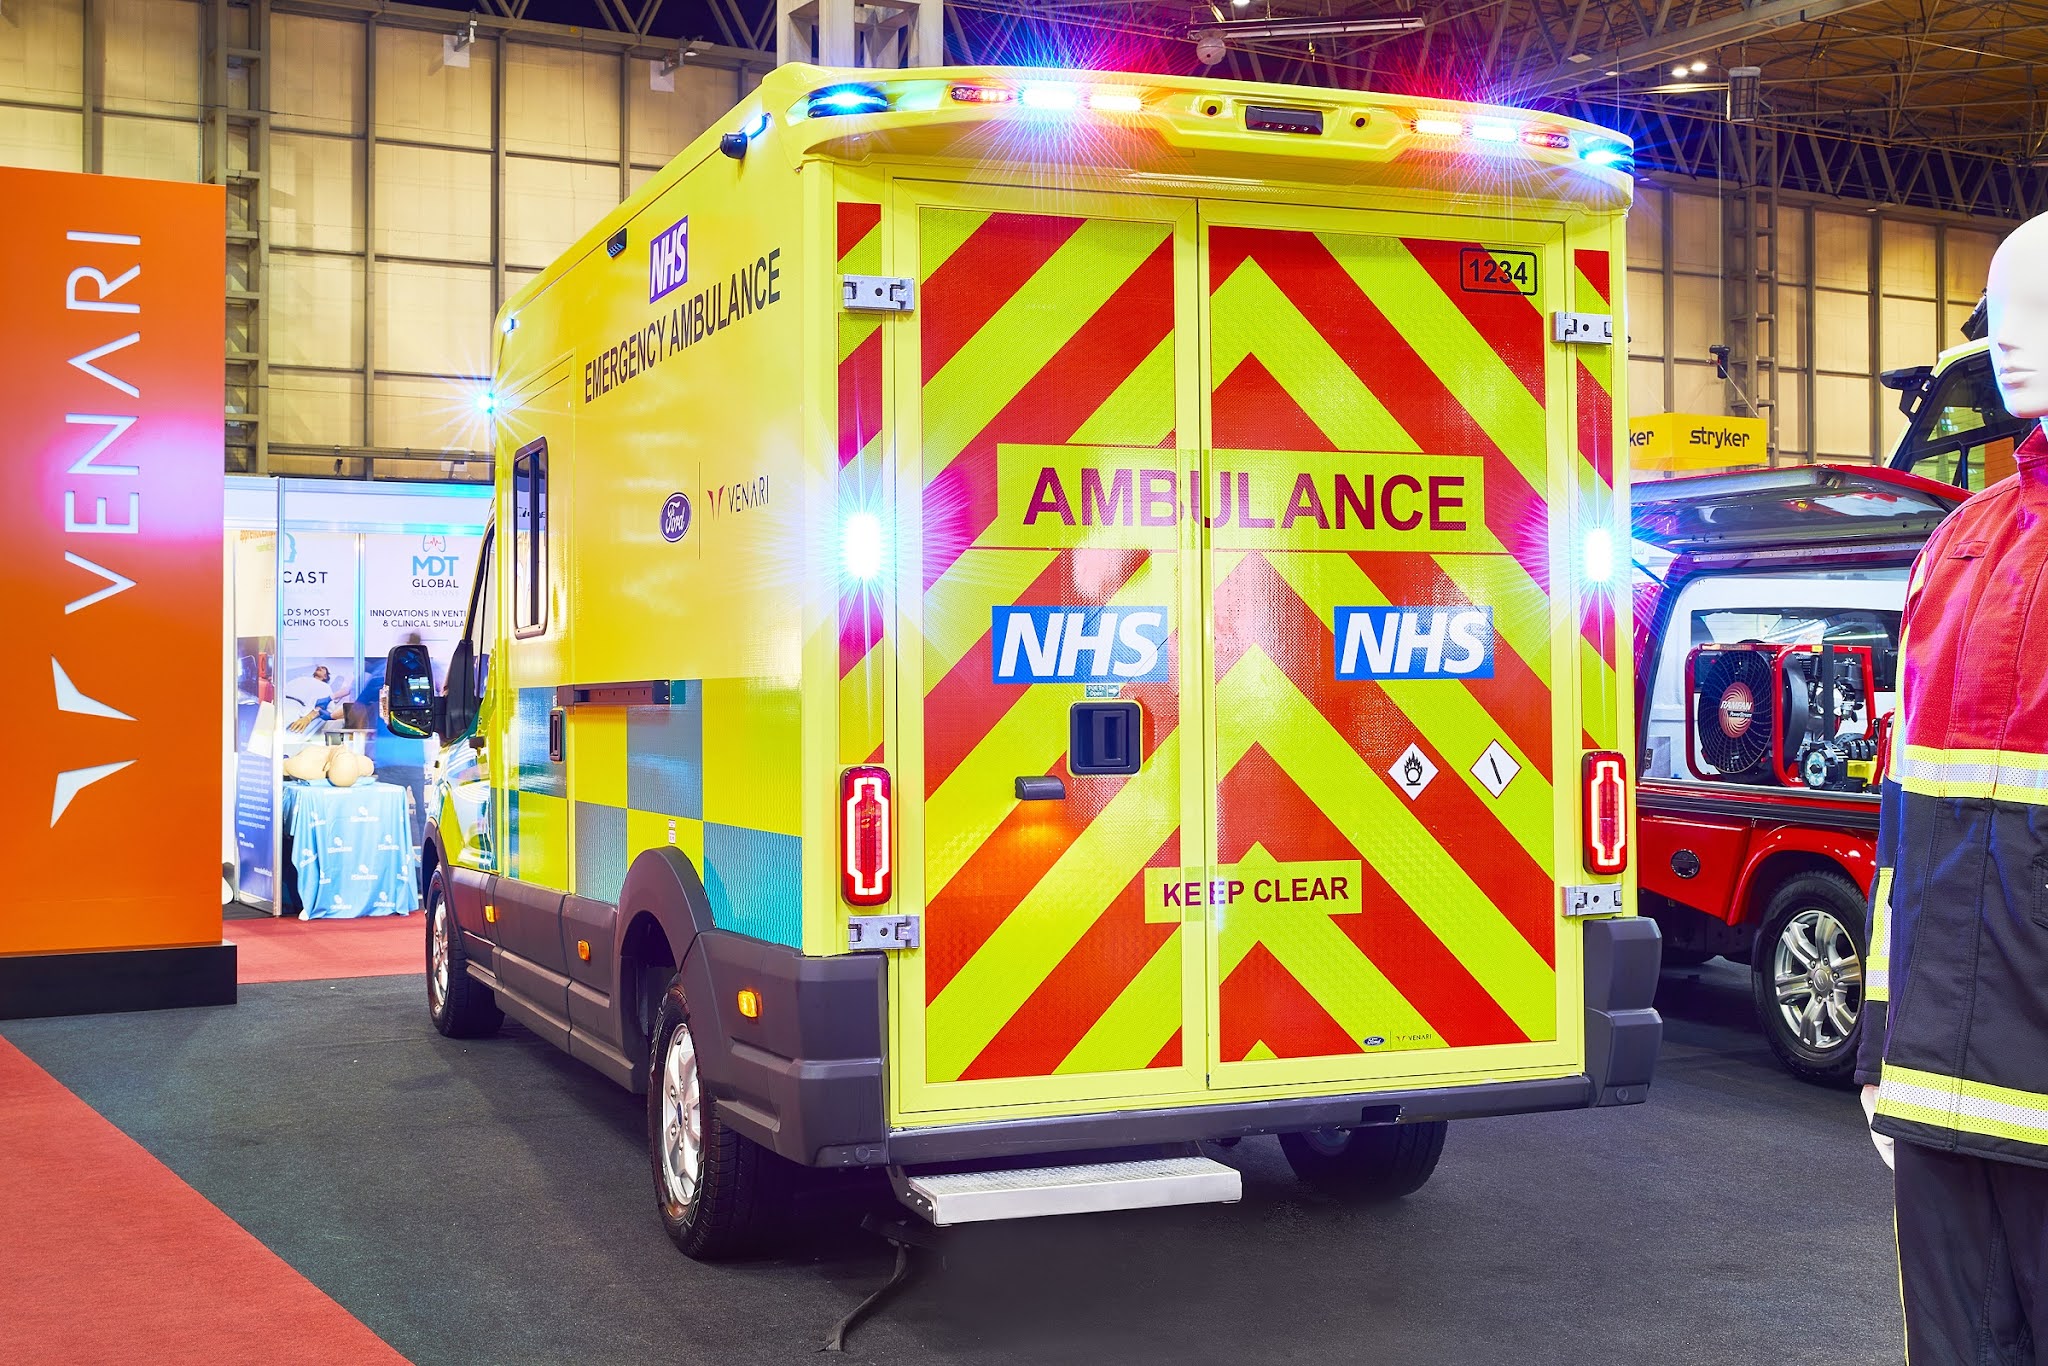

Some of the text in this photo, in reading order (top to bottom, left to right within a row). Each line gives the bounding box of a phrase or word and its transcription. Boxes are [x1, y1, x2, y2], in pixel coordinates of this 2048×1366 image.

[651, 221, 688, 298] NHS
[1469, 258, 1528, 285] 1234
[585, 247, 781, 404] EMERGENCY AMBULANCE
[65, 231, 141, 615] VENARI
[1689, 426, 1750, 449] stryker
[727, 475, 769, 515] VENARI
[1022, 467, 1467, 532] AMBULANCE
[412, 555, 459, 577] MDT
[412, 578, 459, 588] GLOBAL
[304, 608, 331, 616] MOST
[318, 619, 349, 627] TOOLS
[370, 609, 429, 617] INNOVATIONS
[998, 612, 1163, 679] NHS
[1340, 610, 1487, 677] NHS
[1720, 700, 1753, 711] RAMFAN
[1163, 876, 1350, 907] KEEP CLEAR
